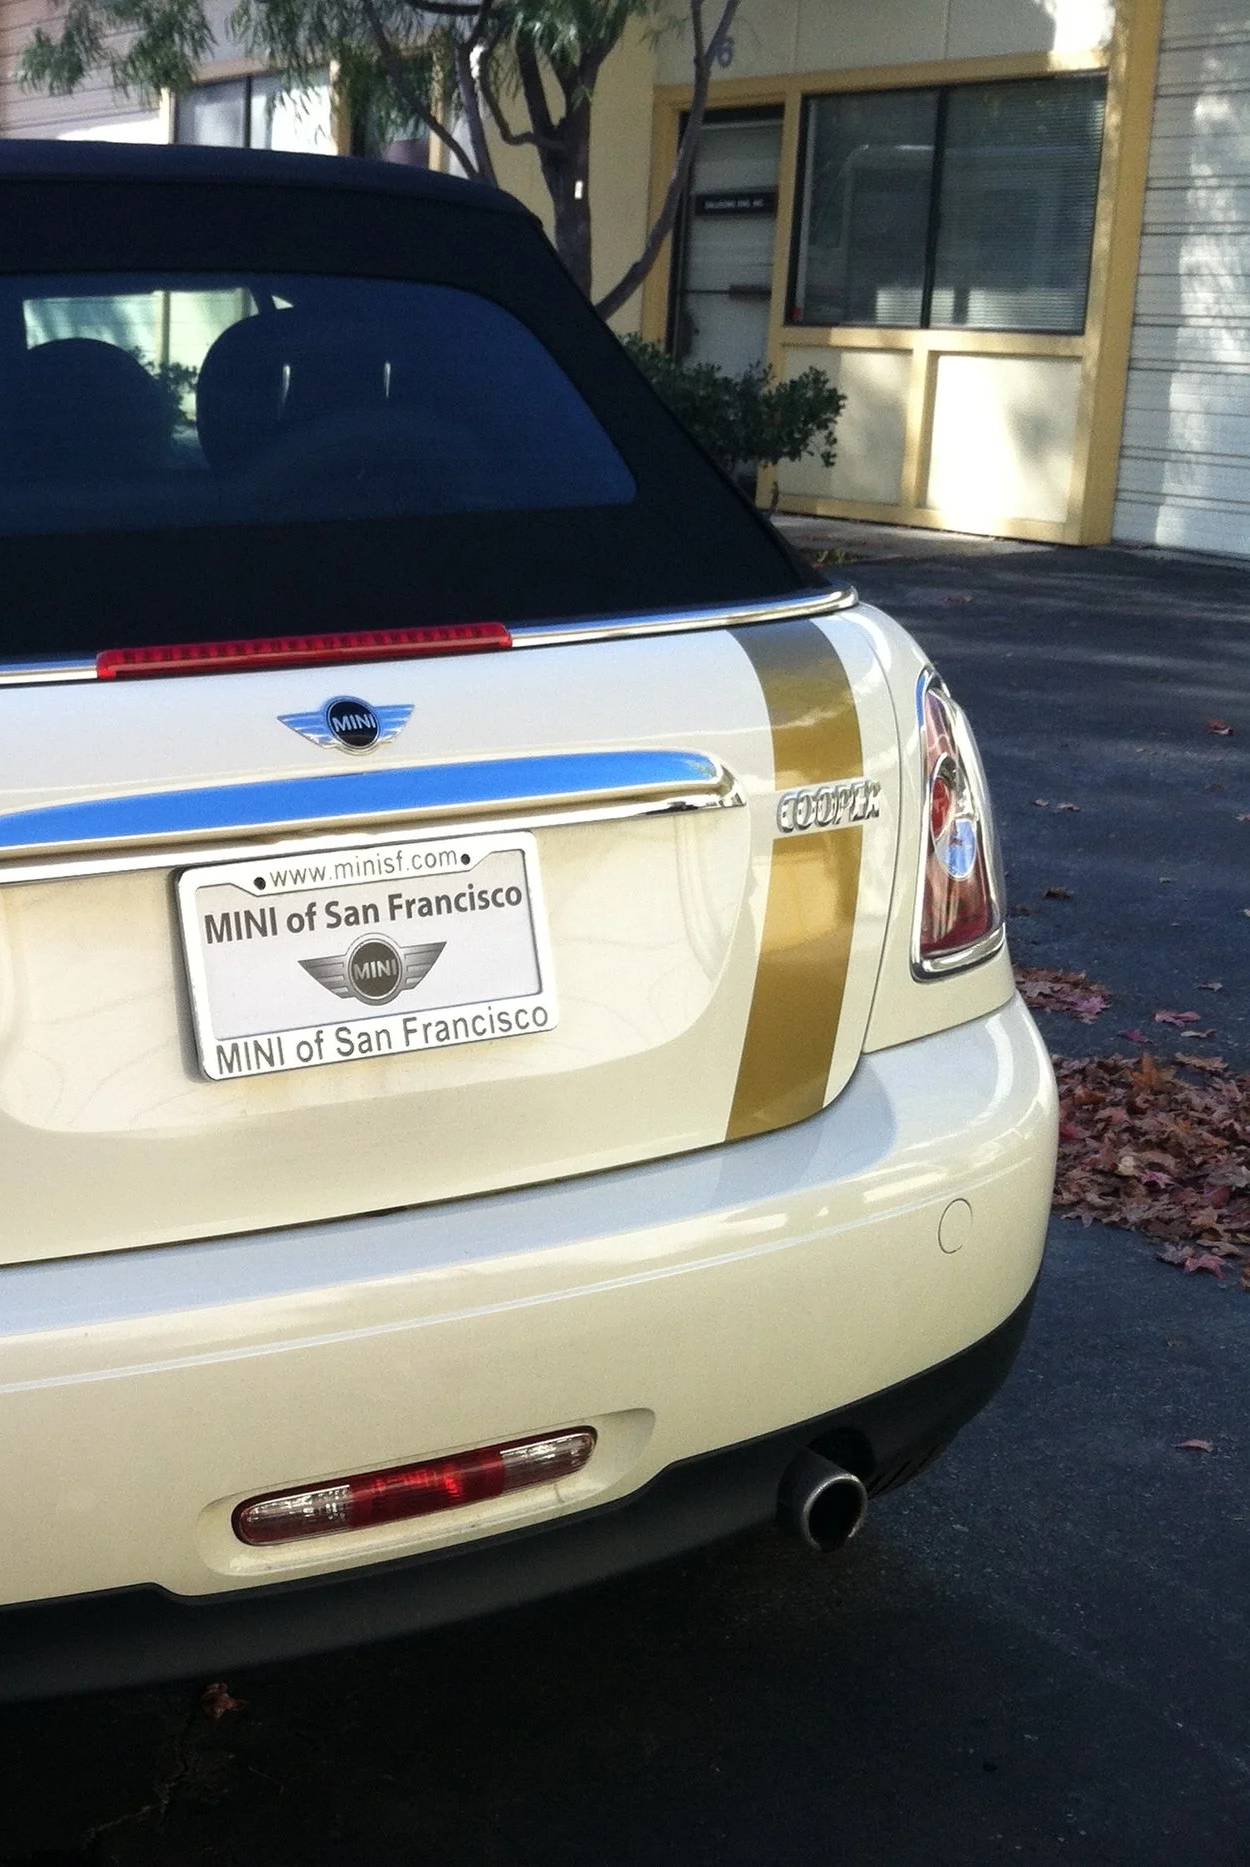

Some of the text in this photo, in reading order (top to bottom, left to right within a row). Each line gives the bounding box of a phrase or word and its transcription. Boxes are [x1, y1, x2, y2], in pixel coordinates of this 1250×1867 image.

[331, 713, 377, 733] MINI
[776, 780, 881, 833] COOPER
[269, 847, 457, 888] www.minisf.com
[204, 882, 523, 945] MINI of San Francisco
[352, 958, 399, 982] MINI
[215, 1005, 549, 1076] MINI of San Francisco
